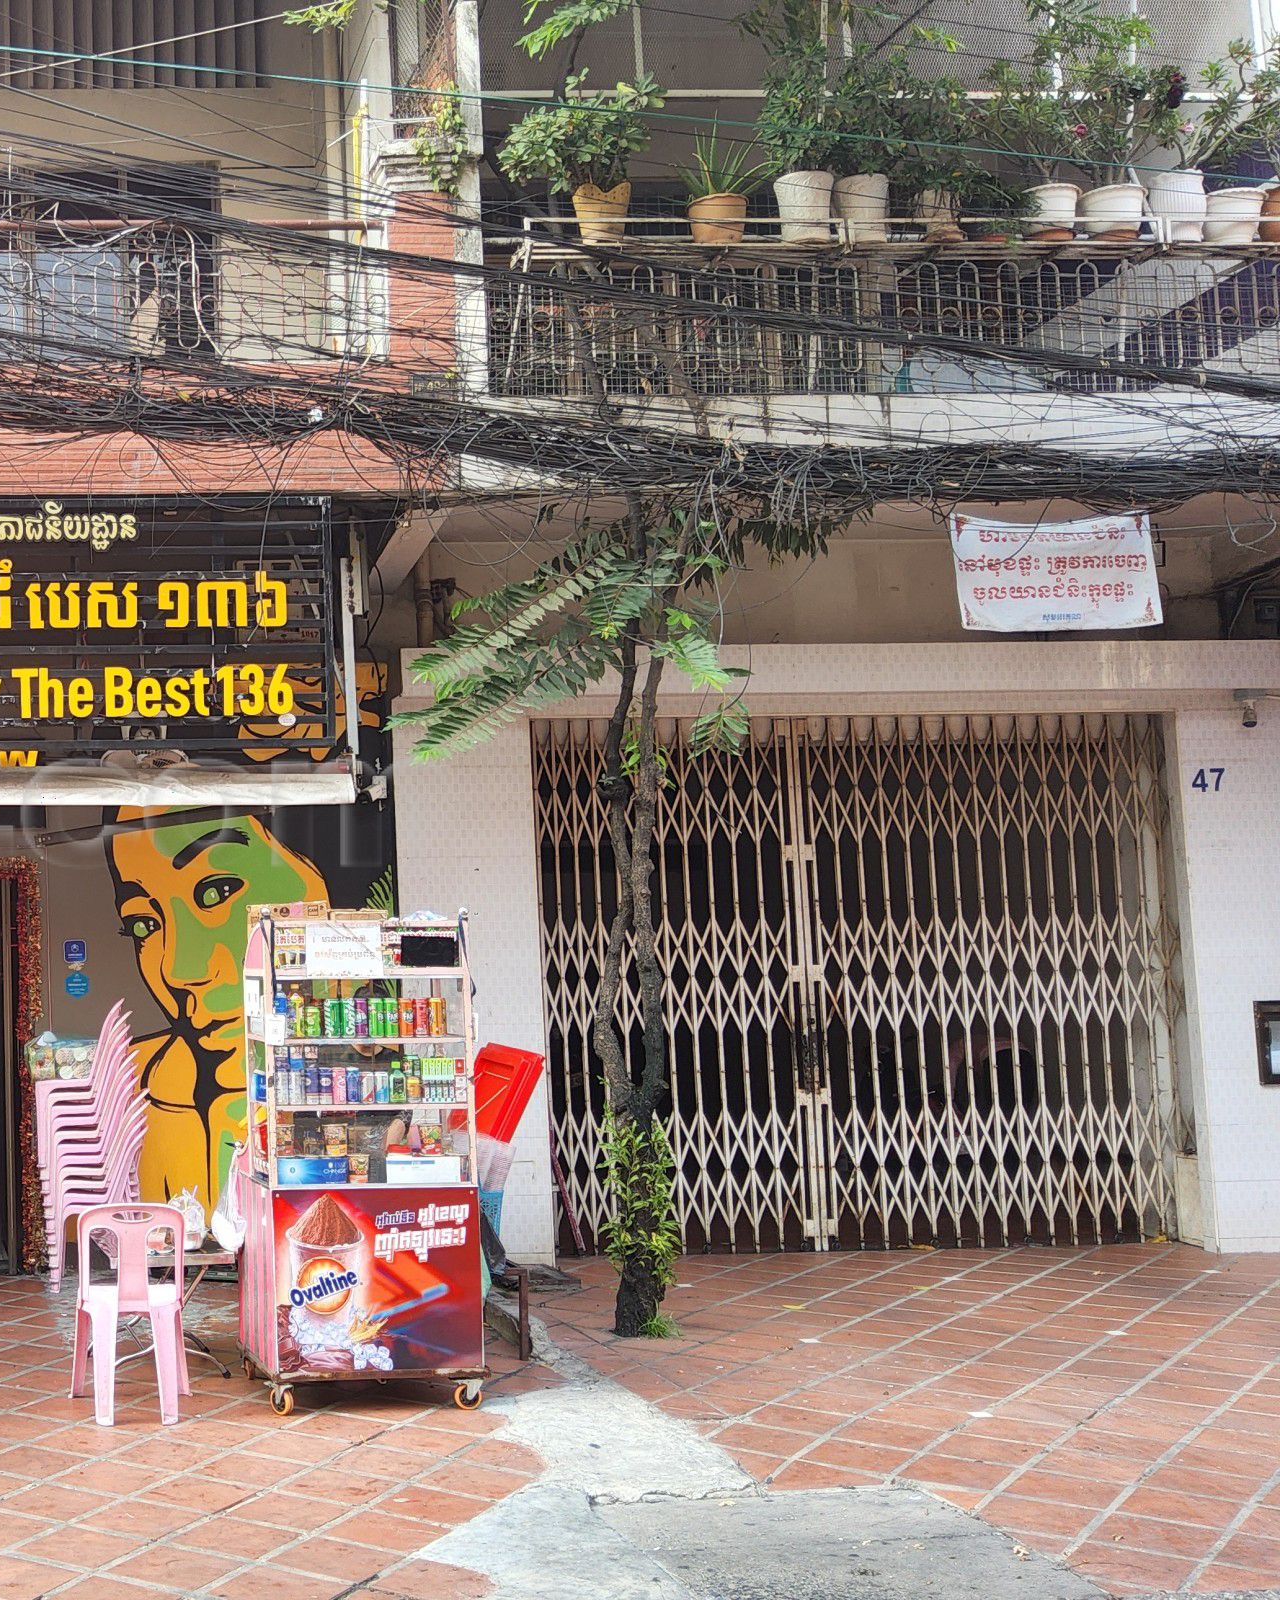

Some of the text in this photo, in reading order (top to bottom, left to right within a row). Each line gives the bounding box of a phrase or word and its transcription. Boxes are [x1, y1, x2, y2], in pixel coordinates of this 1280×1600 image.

[25, 582, 139, 629] បេស
[157, 571, 288, 628] ១៣៦
[12, 668, 95, 719] The
[104, 665, 211, 718] Best
[217, 663, 295, 717] 136
[1192, 767, 1226, 792] 47
[290, 1271, 357, 1306] Ovaltine
